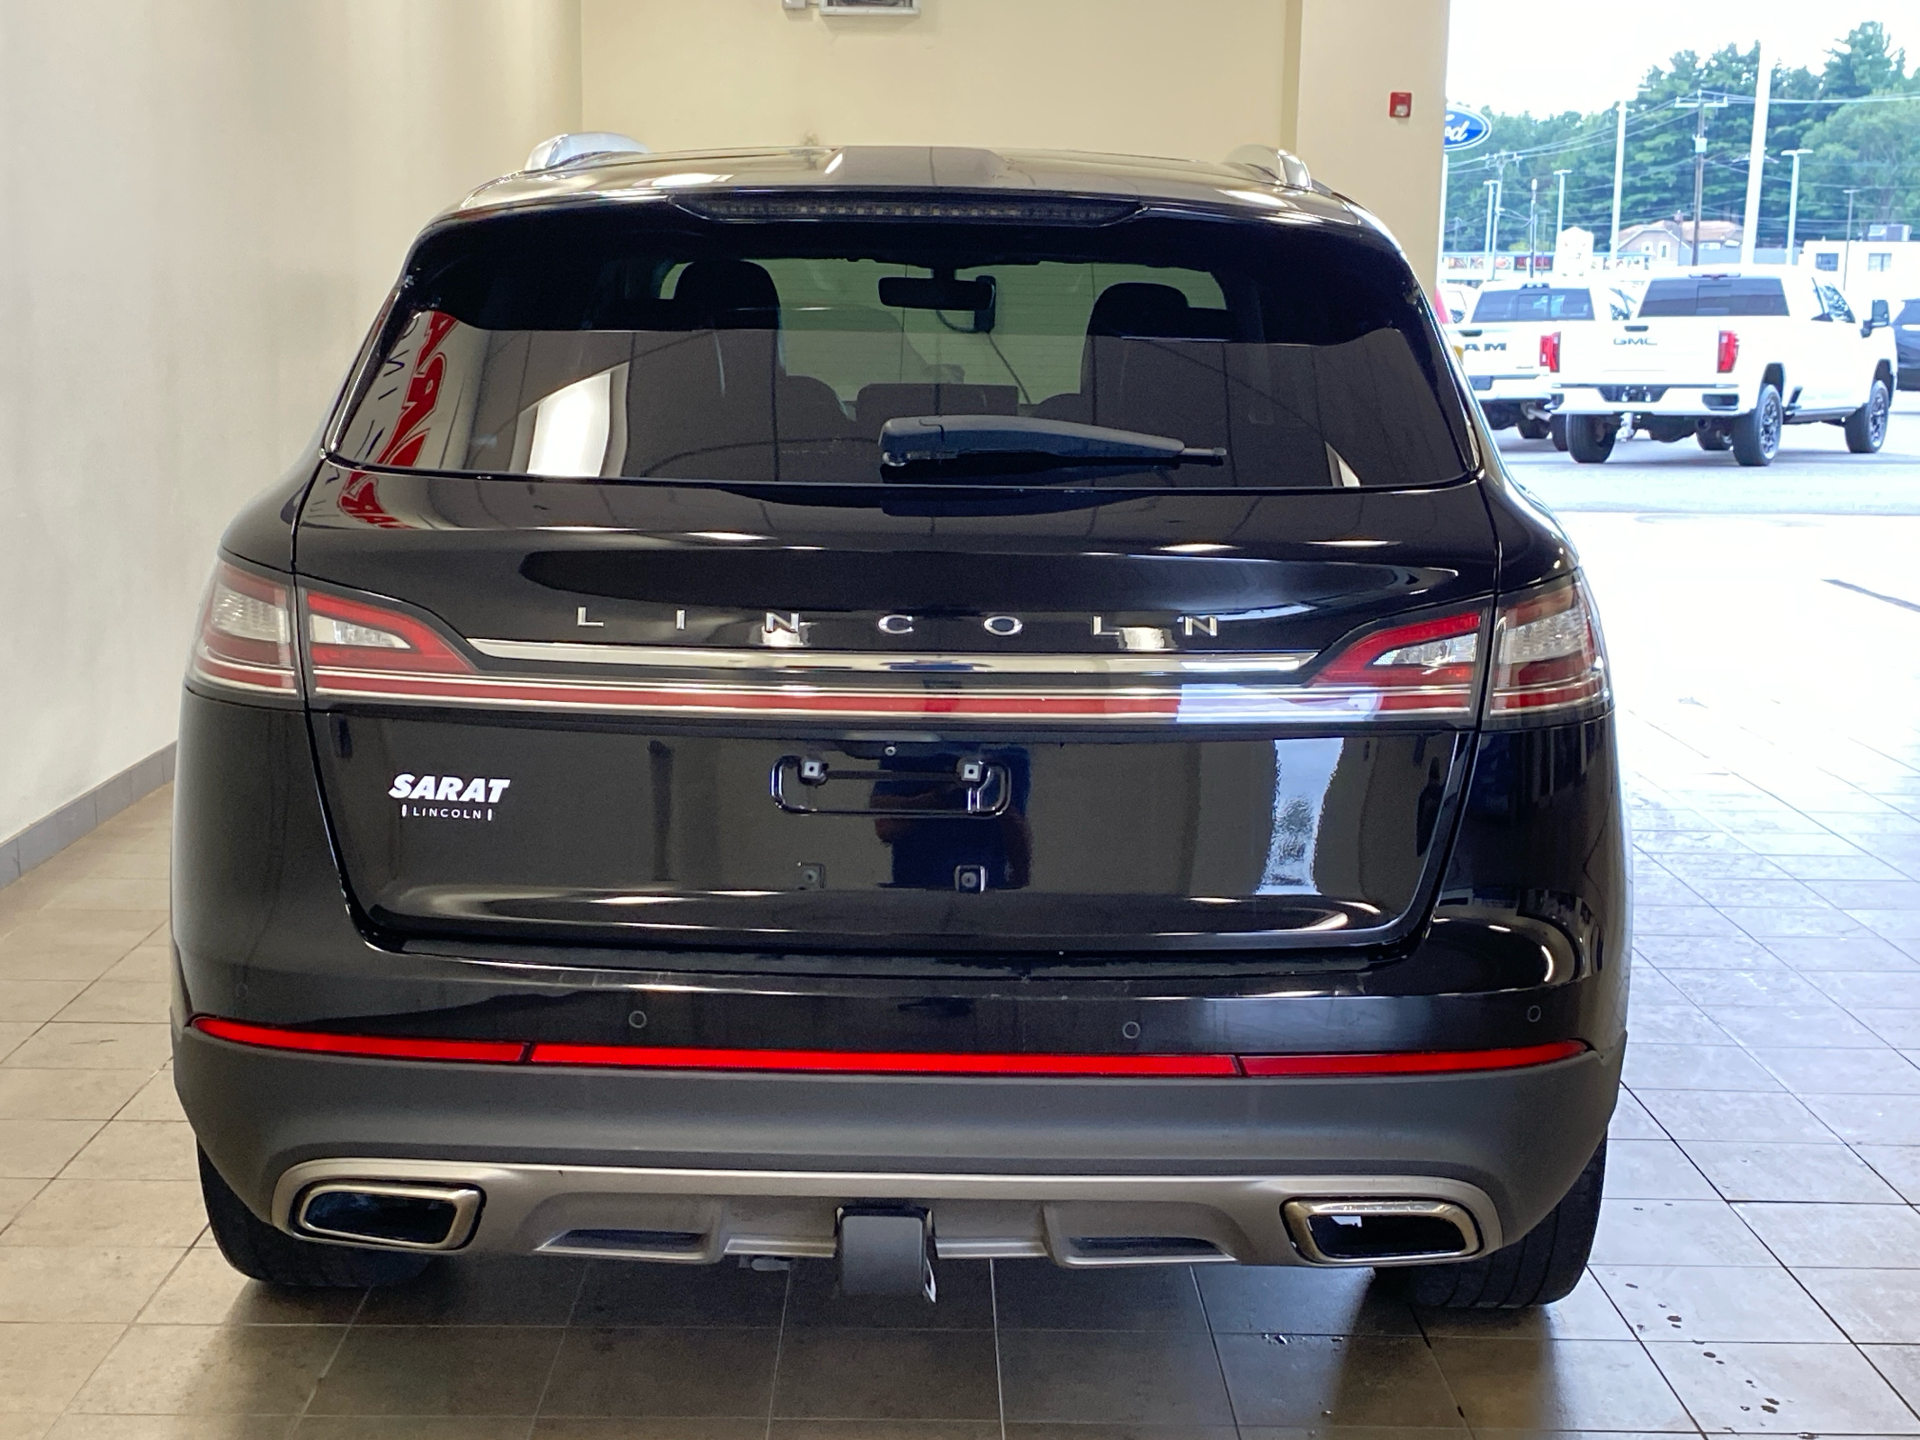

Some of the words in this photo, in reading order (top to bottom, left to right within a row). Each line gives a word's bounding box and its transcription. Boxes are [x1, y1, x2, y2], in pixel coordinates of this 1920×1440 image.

[1464, 342, 1507, 352] AM
[1613, 337, 1658, 346] GMC
[576, 605, 1218, 638] LINCOLN
[387, 773, 512, 804] SARAT
[412, 806, 482, 820] LINCOLN
